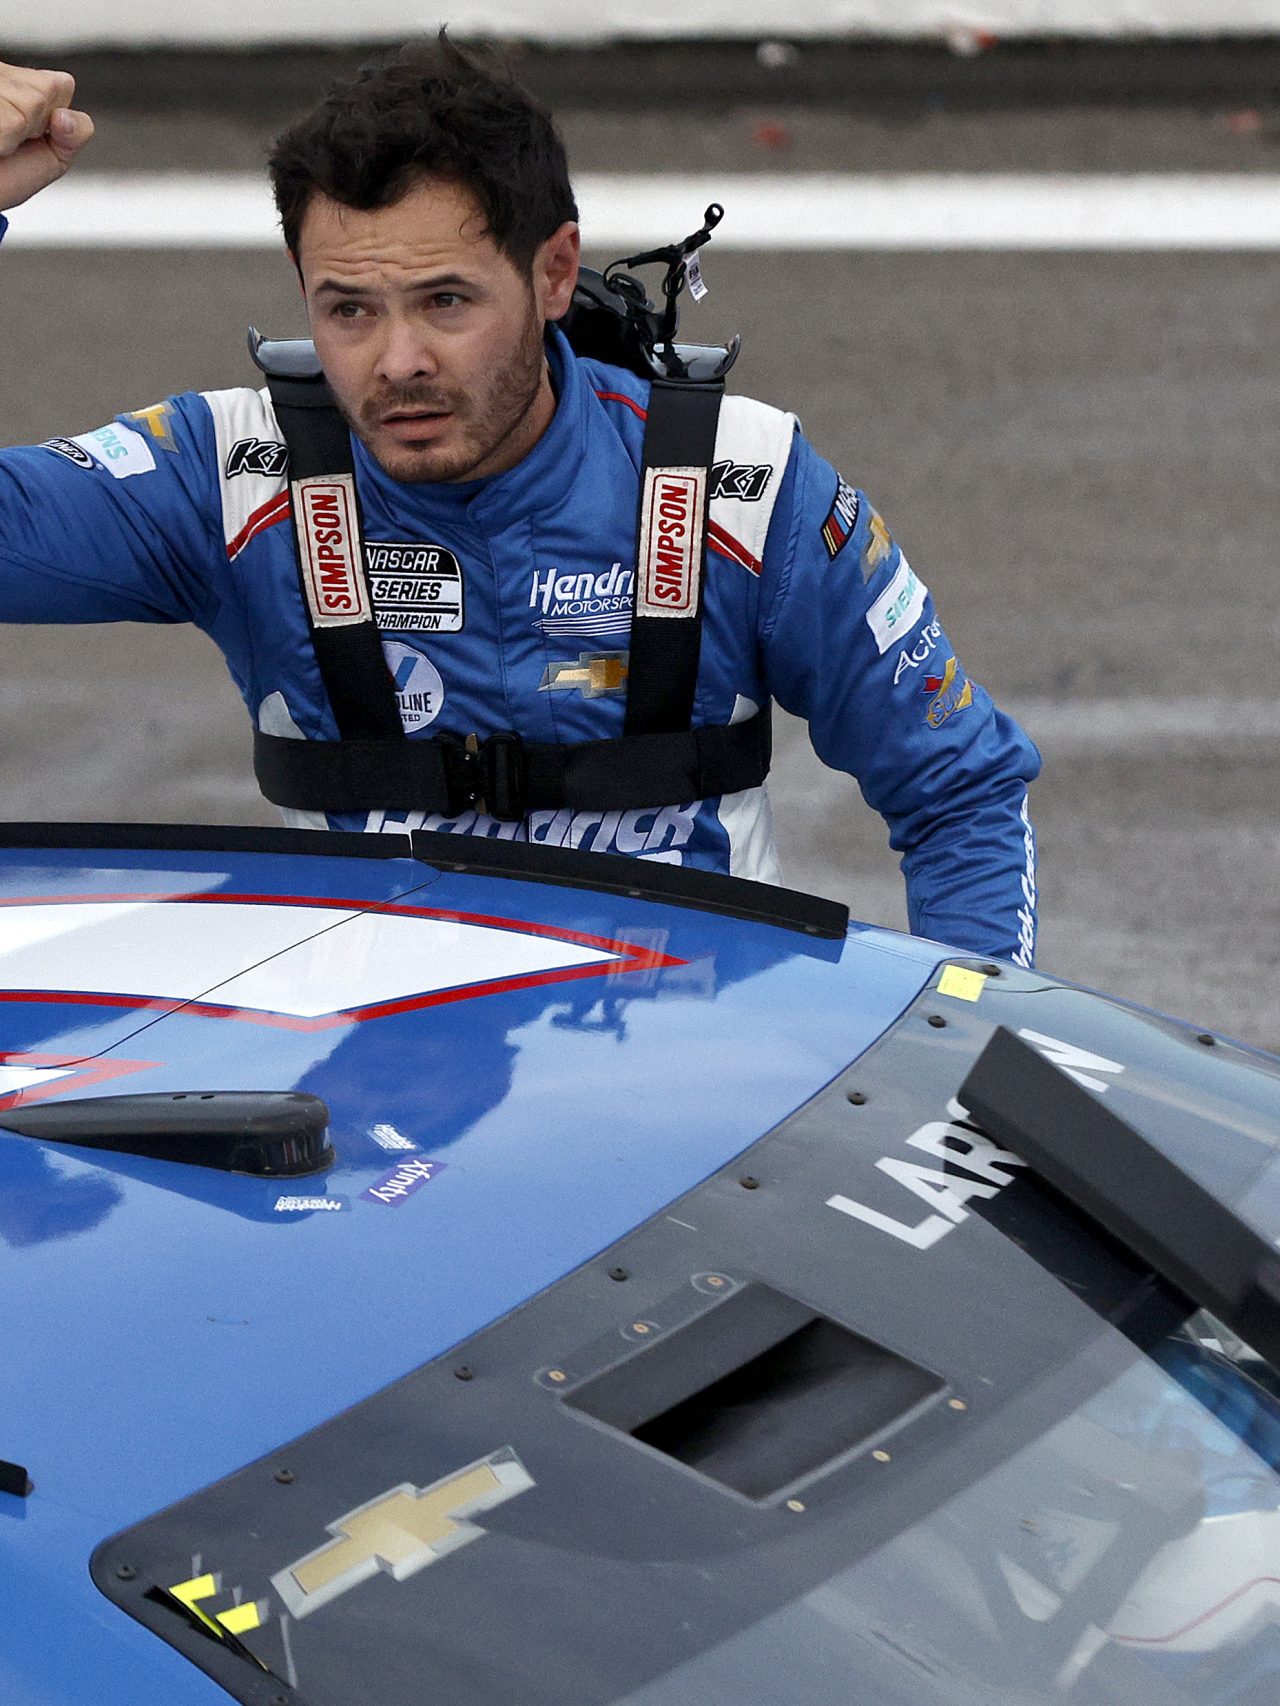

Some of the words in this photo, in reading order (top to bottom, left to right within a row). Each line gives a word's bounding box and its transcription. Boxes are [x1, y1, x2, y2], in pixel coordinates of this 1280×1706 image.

[310, 494, 352, 610] SIMPSON
[366, 548, 440, 572] NASCAR
[375, 580, 442, 601] SERIES
[654, 483, 689, 603] SIMPSON
[825, 1027, 1126, 1250] LARN
